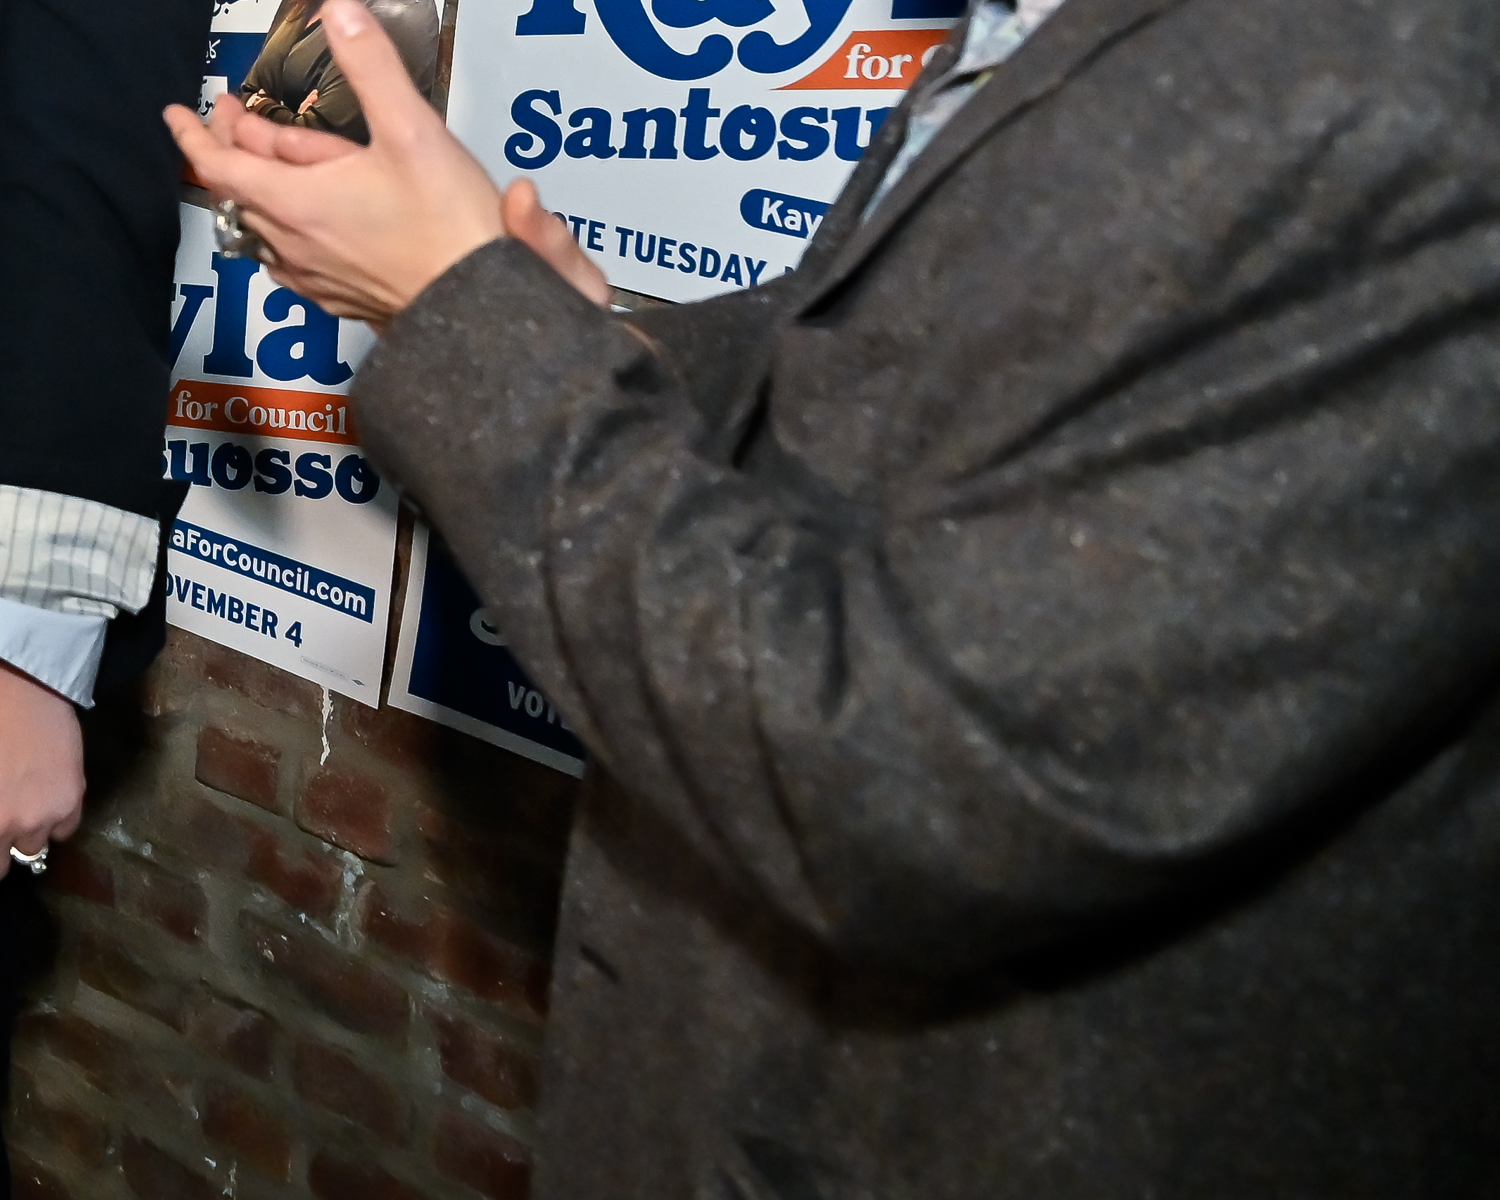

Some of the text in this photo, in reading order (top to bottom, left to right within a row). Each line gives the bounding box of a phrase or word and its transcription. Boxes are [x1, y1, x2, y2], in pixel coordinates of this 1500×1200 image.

[844, 43, 912, 80] for
[175, 390, 347, 435] for Council
[284, 620, 303, 650] 4
